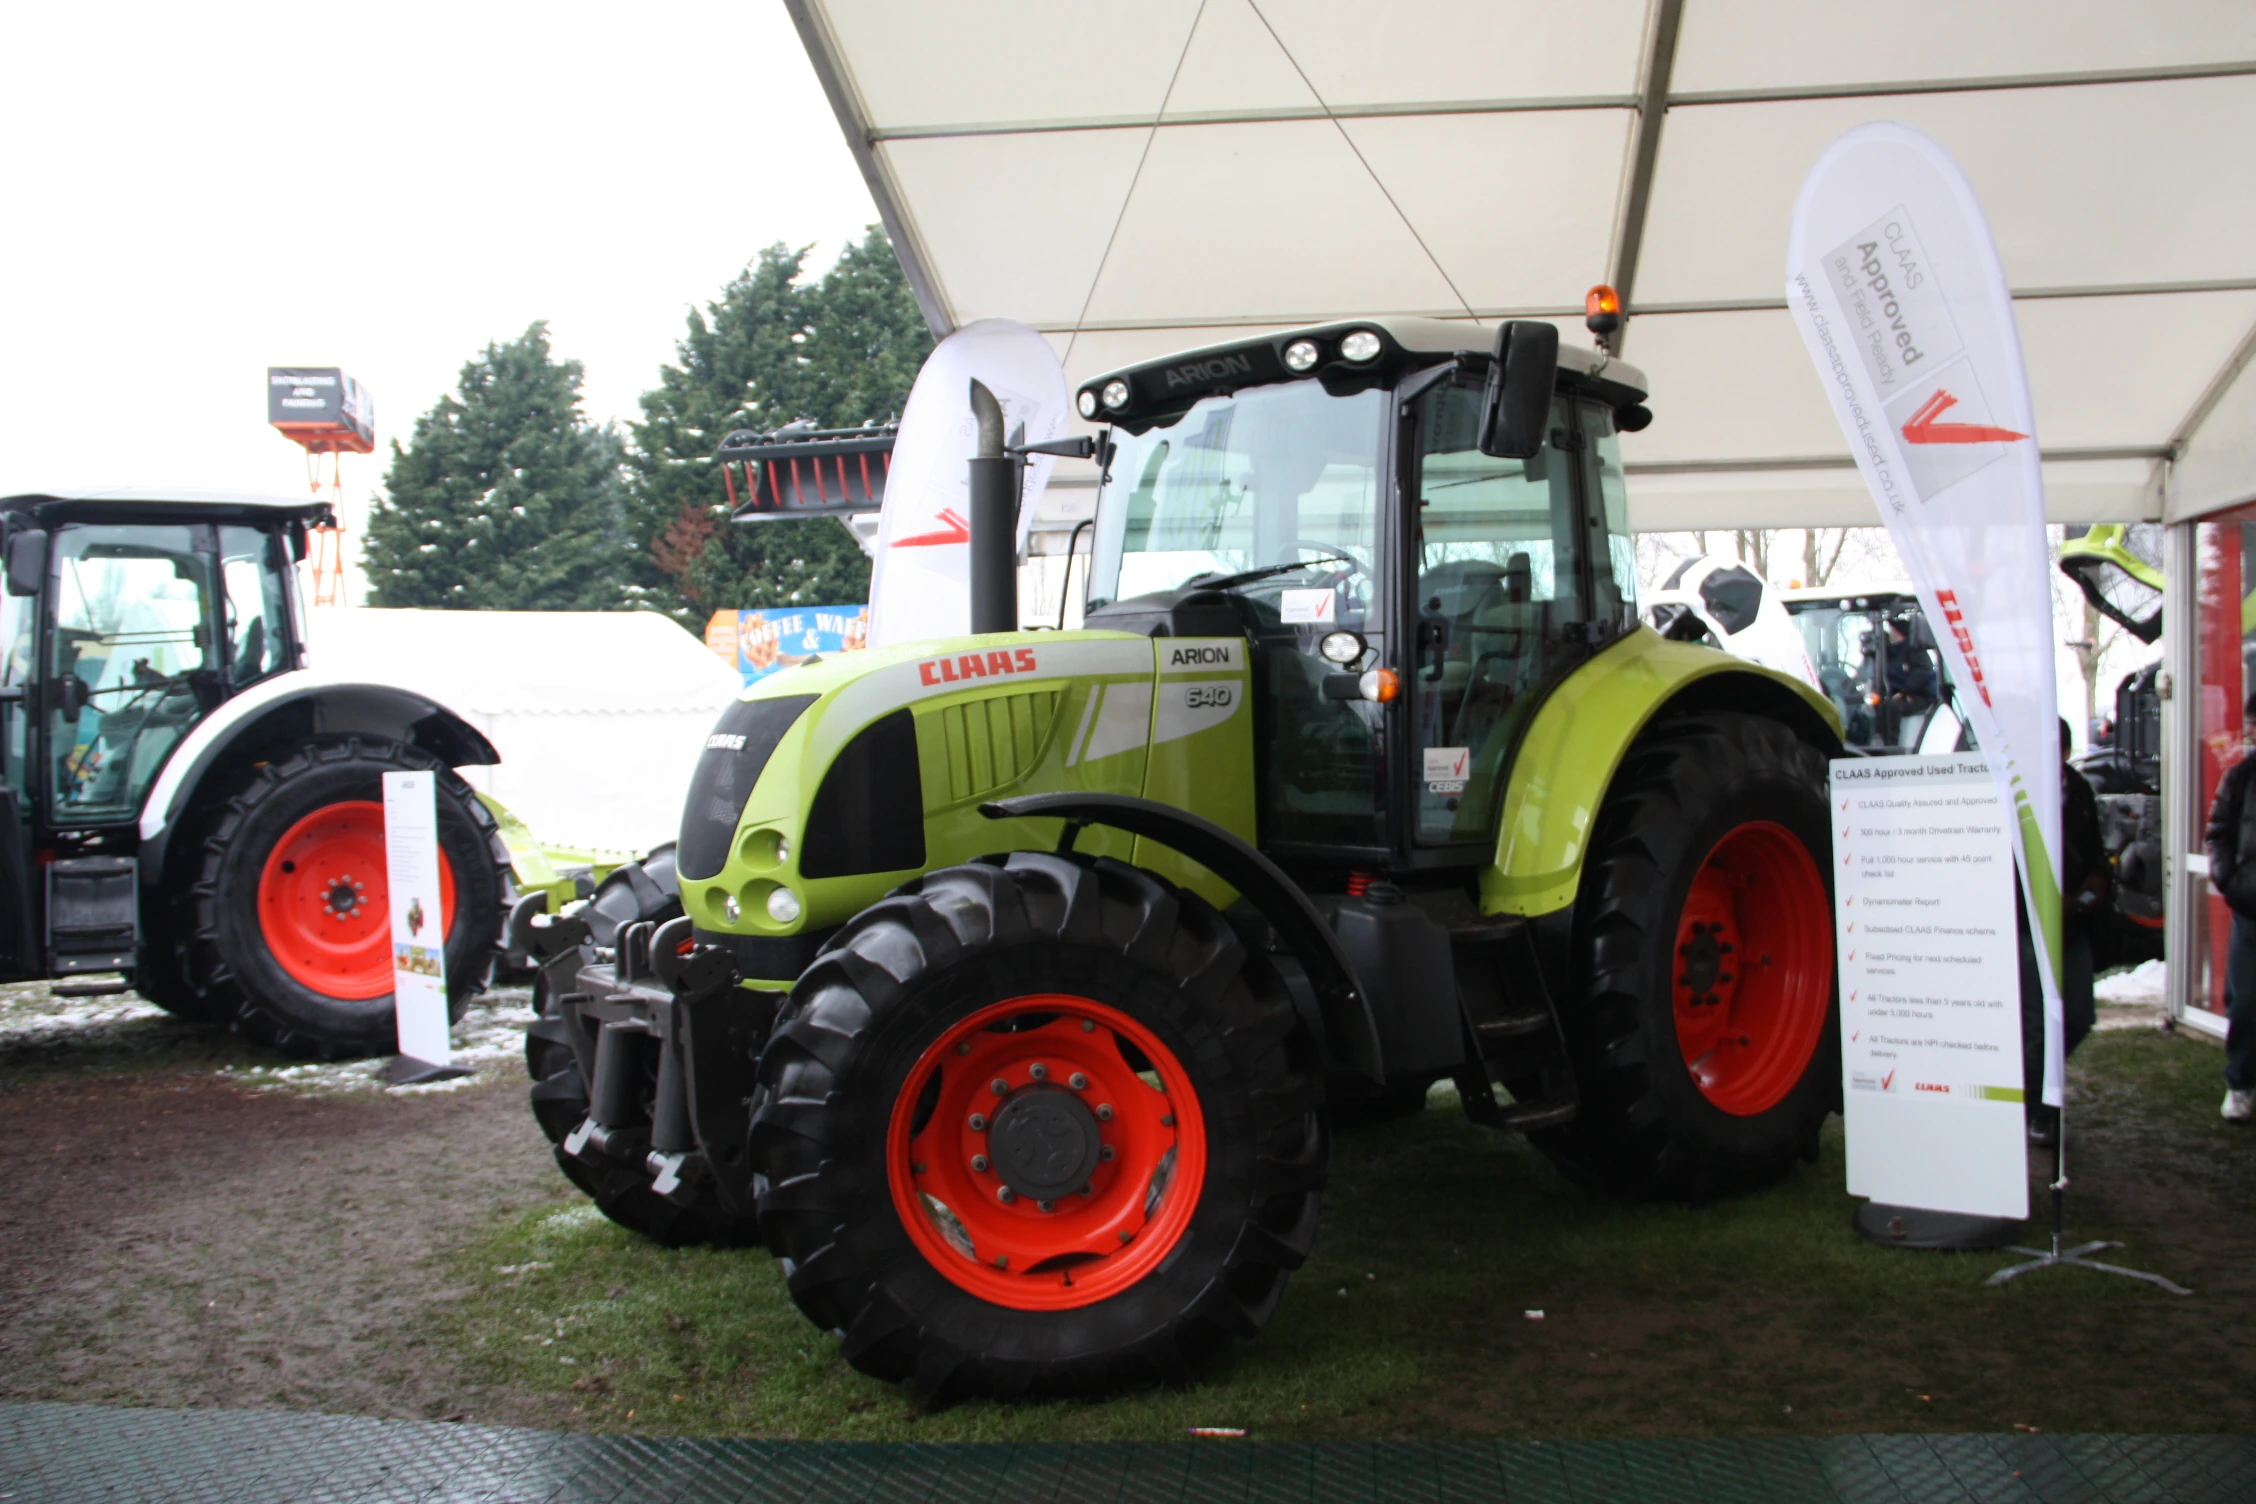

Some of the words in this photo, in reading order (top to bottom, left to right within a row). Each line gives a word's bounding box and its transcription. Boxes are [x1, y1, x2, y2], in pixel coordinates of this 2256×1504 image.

[1884, 221, 1924, 290] CLAAS
[1856, 241, 1924, 366] Approved
[1834, 256, 1858, 288] and
[1851, 288, 1875, 330] Field
[1867, 330, 1895, 385] Ready
[1165, 353, 1252, 388] ARION
[1794, 271, 1906, 517] www.claasapprovedused.co.uk
[739, 613, 804, 651] COFFEE
[802, 627, 820, 650] &
[1171, 645, 1230, 666] ARION
[918, 647, 1038, 687] CLAAS
[1184, 685, 1232, 708] 640
[706, 733, 747, 750] CLAAS
[1835, 768, 1871, 780] CLAAS
[1873, 765, 1924, 781] Approved
[1926, 763, 1954, 775] Used
[1429, 781, 1464, 793] CEBIS
[1858, 800, 1884, 809] CLAAS
[1886, 800, 1911, 810] Quality
[1913, 798, 1943, 807] Assured
[1945, 798, 1959, 806] and
[1961, 796, 1998, 807] Approved
[1874, 827, 1890, 836] hour
[1903, 826, 1927, 836] month
[1928, 825, 1965, 835] Drivetrain
[1966, 825, 2001, 837] Warranty
[1861, 855, 1874, 864] Full
[1897, 855, 1914, 864] hour
[1915, 855, 1943, 864] service
[1943, 854, 1960, 863] with
[1972, 854, 1993, 865] point
[1861, 869, 1882, 878] check
[1884, 869, 1895, 877] list
[1862, 897, 1913, 907] Dynamometer
[1914, 897, 1941, 907] Report
[1864, 924, 1903, 934] Subsidised
[1904, 925, 1932, 934] CLAAS
[1933, 926, 1964, 935] Finance
[1965, 927, 1996, 936] scheme
[1865, 952, 1885, 961] Fixed
[1886, 953, 1912, 964] Pricing
[1913, 953, 1923, 962] for
[1924, 955, 1941, 963] next
[1943, 955, 1982, 965] scheduled
[1866, 967, 1896, 976] services
[1867, 993, 1877, 1002] All
[1878, 993, 1907, 1003] Tractors
[1908, 995, 1924, 1005] less
[1925, 996, 1942, 1006] than
[1950, 998, 1972, 1009] years
[1973, 998, 1985, 1008] old
[1986, 999, 2003, 1008] with
[1867, 1008, 1888, 1017] under
[1911, 1010, 1933, 1019] hours
[1869, 1034, 1878, 1044] All
[1879, 1035, 1909, 1045] Tractors
[1910, 1038, 1923, 1047] are
[1924, 1038, 1939, 1047] HPI
[1940, 1039, 1972, 1050] checked
[1973, 1042, 1999, 1052] before
[1869, 1049, 1897, 1060] delivery
[1915, 1082, 1950, 1093] CLAAS
